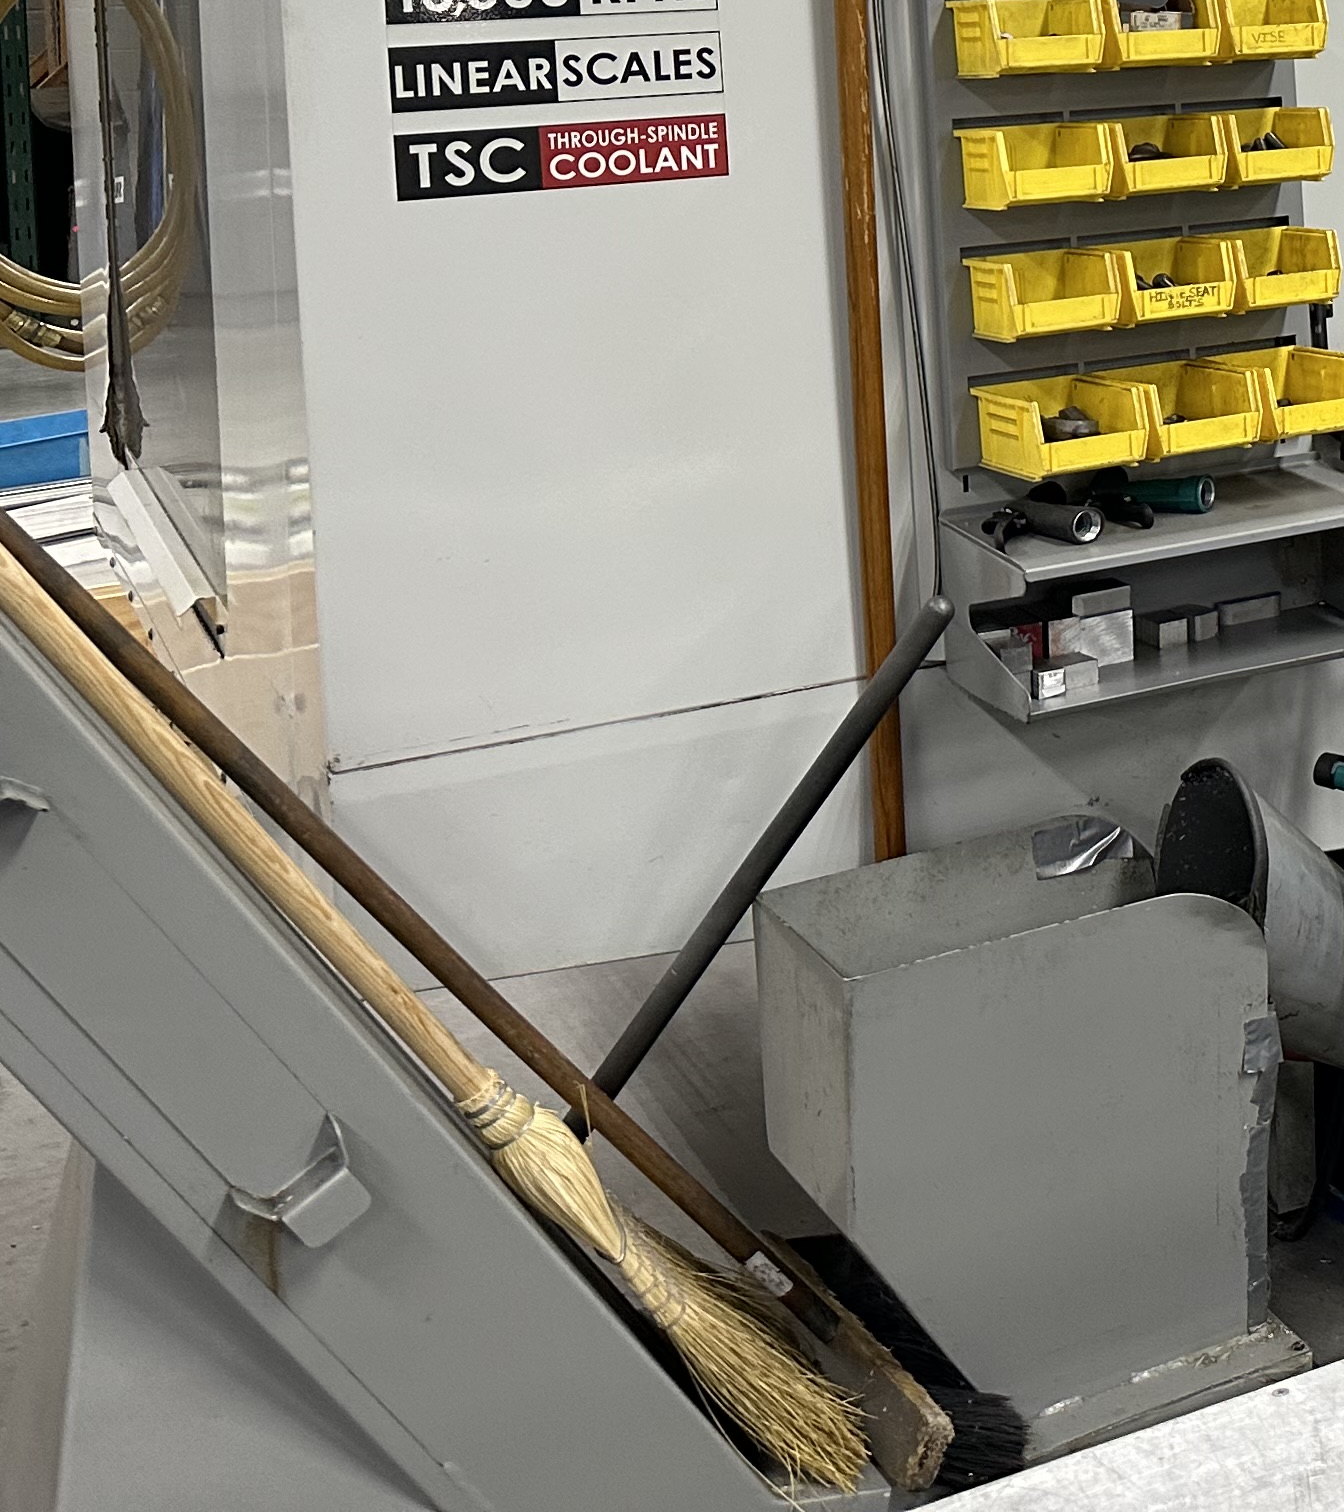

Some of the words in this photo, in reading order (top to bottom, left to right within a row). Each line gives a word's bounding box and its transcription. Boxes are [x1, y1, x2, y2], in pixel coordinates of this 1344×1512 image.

[1251, 30, 1287, 44] VISE
[394, 57, 553, 99] LINEAR
[562, 47, 717, 87] SCALES
[409, 138, 527, 188] TSC
[548, 122, 719, 150] THROUGH-SPINDLE
[550, 144, 719, 181] COOLANT
